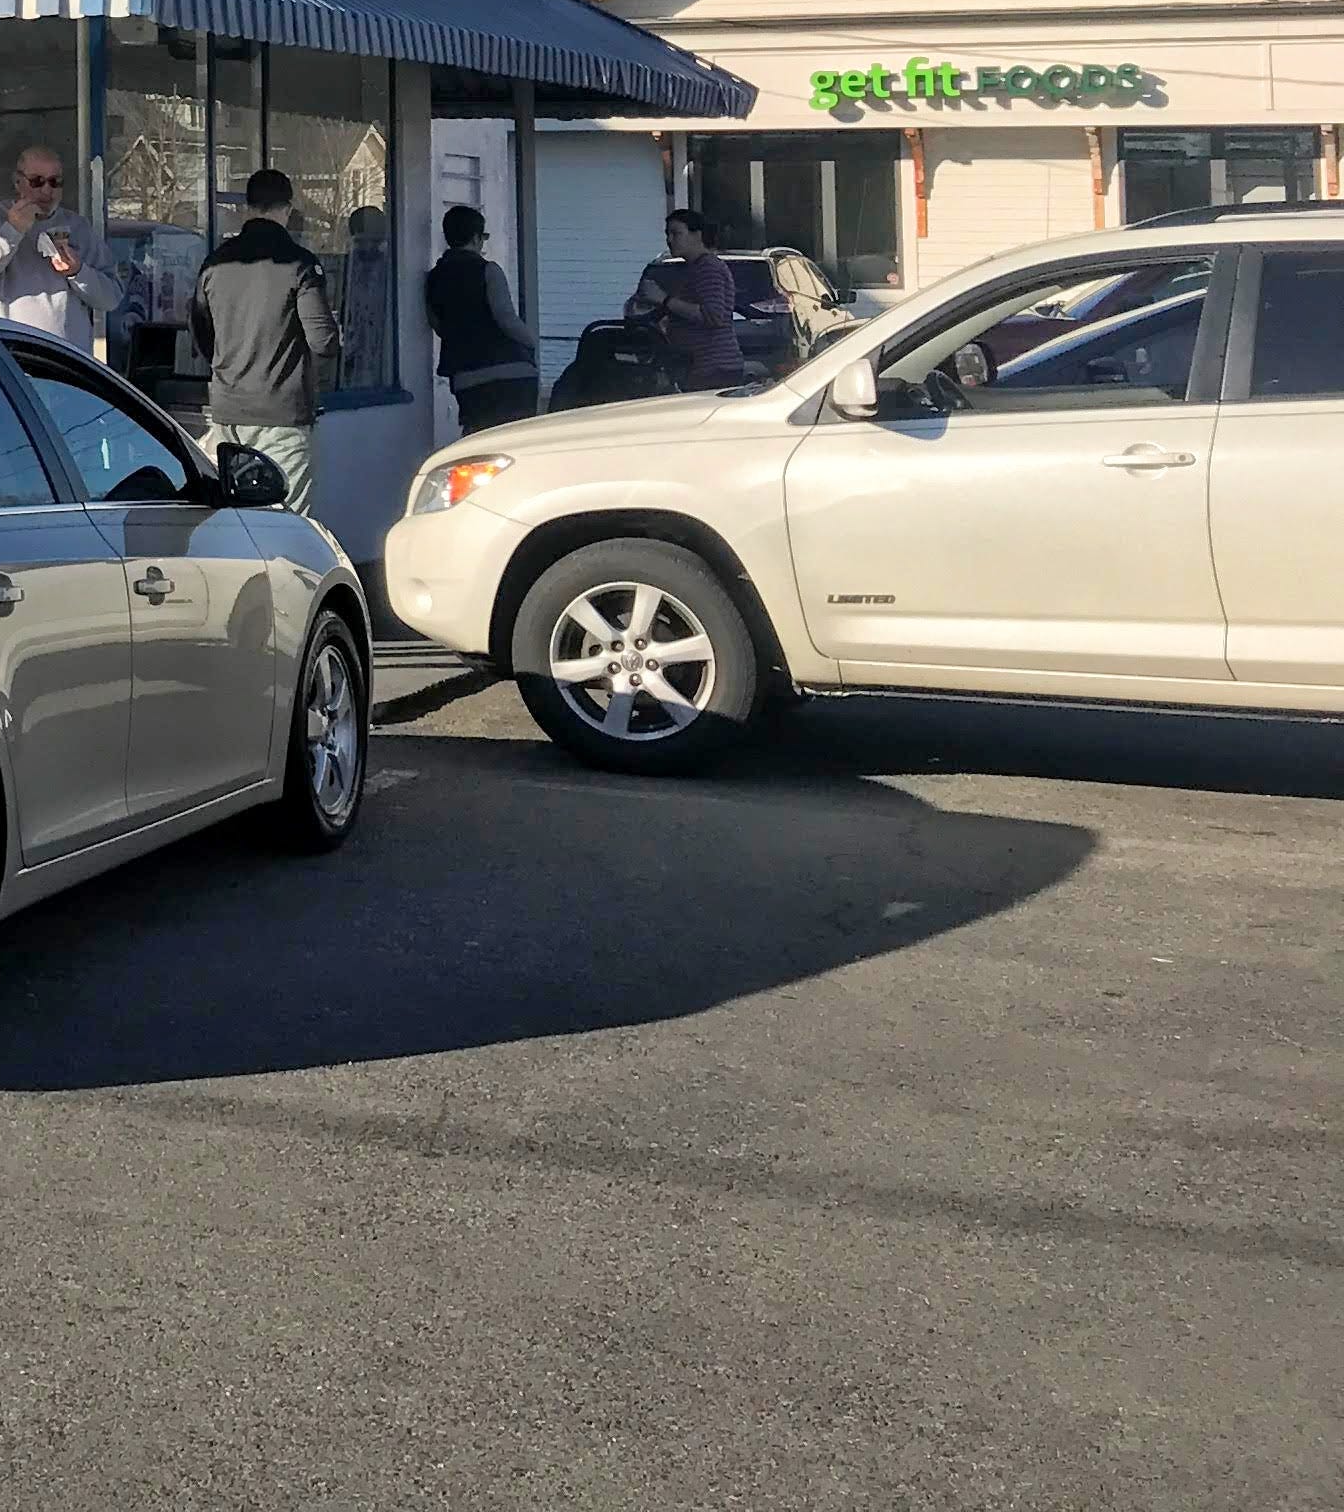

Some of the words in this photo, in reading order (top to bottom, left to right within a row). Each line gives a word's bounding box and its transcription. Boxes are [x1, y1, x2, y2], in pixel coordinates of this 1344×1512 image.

[808, 62, 891, 111] get
[902, 56, 962, 97] fit
[976, 62, 1145, 96] FOODS
